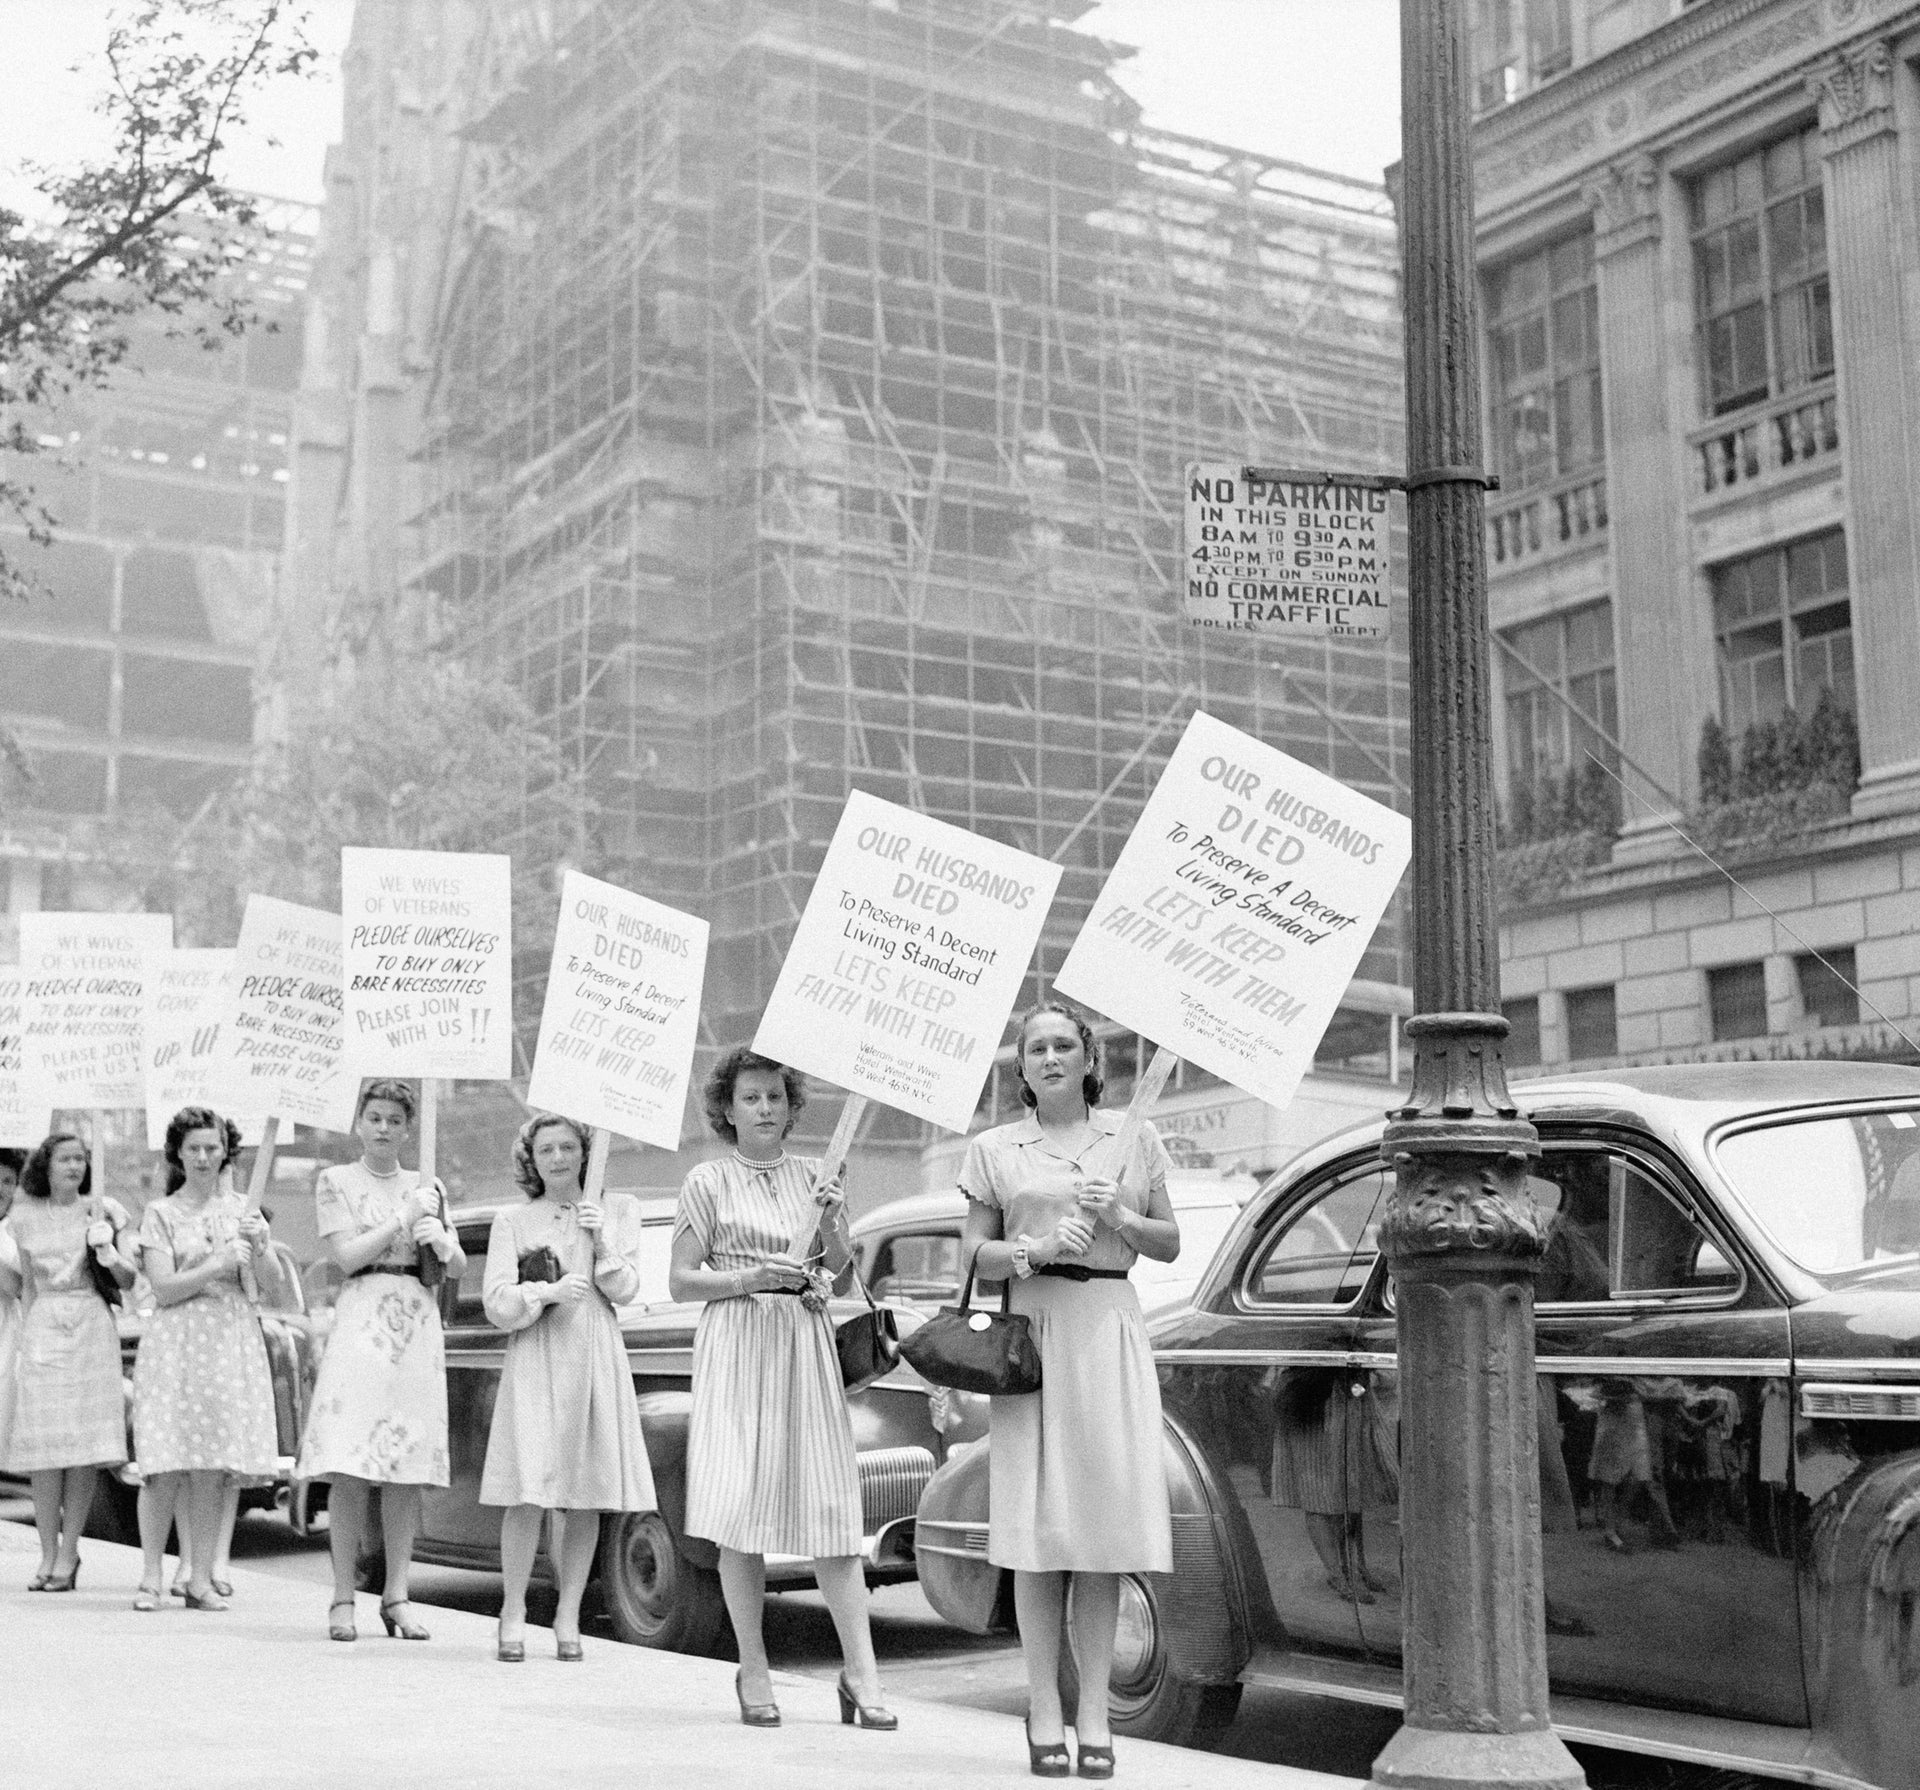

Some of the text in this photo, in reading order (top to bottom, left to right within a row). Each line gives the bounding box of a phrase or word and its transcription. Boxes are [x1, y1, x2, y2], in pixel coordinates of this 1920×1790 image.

[1191, 478, 1386, 514] NO PARKING
[1201, 506, 1375, 532] IN THIS BLOCK
[1196, 564, 1380, 585] EXCEPT ON SUNDAY
[1189, 580, 1388, 608] NO COMMERCIAL
[1192, 618, 1380, 636] POLICE DEPT
[1229, 601, 1350, 625] TRAFFIC
[1200, 756, 1384, 865] OUR HUSBANDS
[1217, 804, 1305, 865] DIED
[857, 826, 1035, 911] OUR HUSBANDS
[1166, 821, 1361, 931] To Preserve A Decent
[379, 876, 461, 895] WE WIVES
[892, 873, 959, 916] DIED
[364, 897, 471, 917] OF VETERANS
[1175, 859, 1332, 946] Living Standard
[277, 928, 343, 956] WE WIVE
[350, 923, 500, 954] PLEDGE OURSELVES
[575, 899, 690, 959] OUR HUSBANDS
[839, 889, 998, 966] To Preserve A Decent
[87, 936, 133, 951] WIVES
[257, 944, 280, 960] OF
[594, 933, 643, 971] DIED
[843, 918, 984, 987] Living Standard
[1210, 922, 1287, 965] KEEP
[375, 955, 486, 974] TO BUY ONLY
[1100, 905, 1307, 1027] FAITH WITH THEM
[25, 977, 84, 997] PLEDGE
[239, 975, 303, 999] PLEDGE
[350, 974, 487, 995] BARE NECESSITIES
[566, 954, 688, 1010] To Preserve A Decent
[833, 950, 957, 1014] LETS KEEP
[41, 1003, 143, 1018] TO BUY ONLY
[264, 1000, 340, 1031] TO BUY ONLY
[356, 998, 460, 1033] PLEASE JOIN
[575, 981, 671, 1025] Living Standard
[794, 974, 977, 1063] FAITH WITH THEM
[1185, 1010, 1210, 1026] Hotel
[235, 1012, 344, 1051] BARE NECESSITIES
[386, 1023, 427, 1048] WITH
[569, 1008, 656, 1053] LETS KEEP
[1183, 1018, 1195, 1029] 59
[42, 1046, 96, 1068] PLEASE
[103, 1040, 141, 1059] JOIN
[234, 1037, 340, 1069] PLEASE JOIN
[549, 1031, 677, 1093] FAITH WITH THEM
[859, 1041, 942, 1081] Veterans and Wives
[55, 1066, 96, 1084] WITH
[251, 1062, 292, 1076] WITH
[852, 1064, 866, 1076] 59
[866, 1071, 886, 1086] West
[888, 1079, 900, 1092] 46
[856, 1053, 933, 1090] Hotel Wentworth
